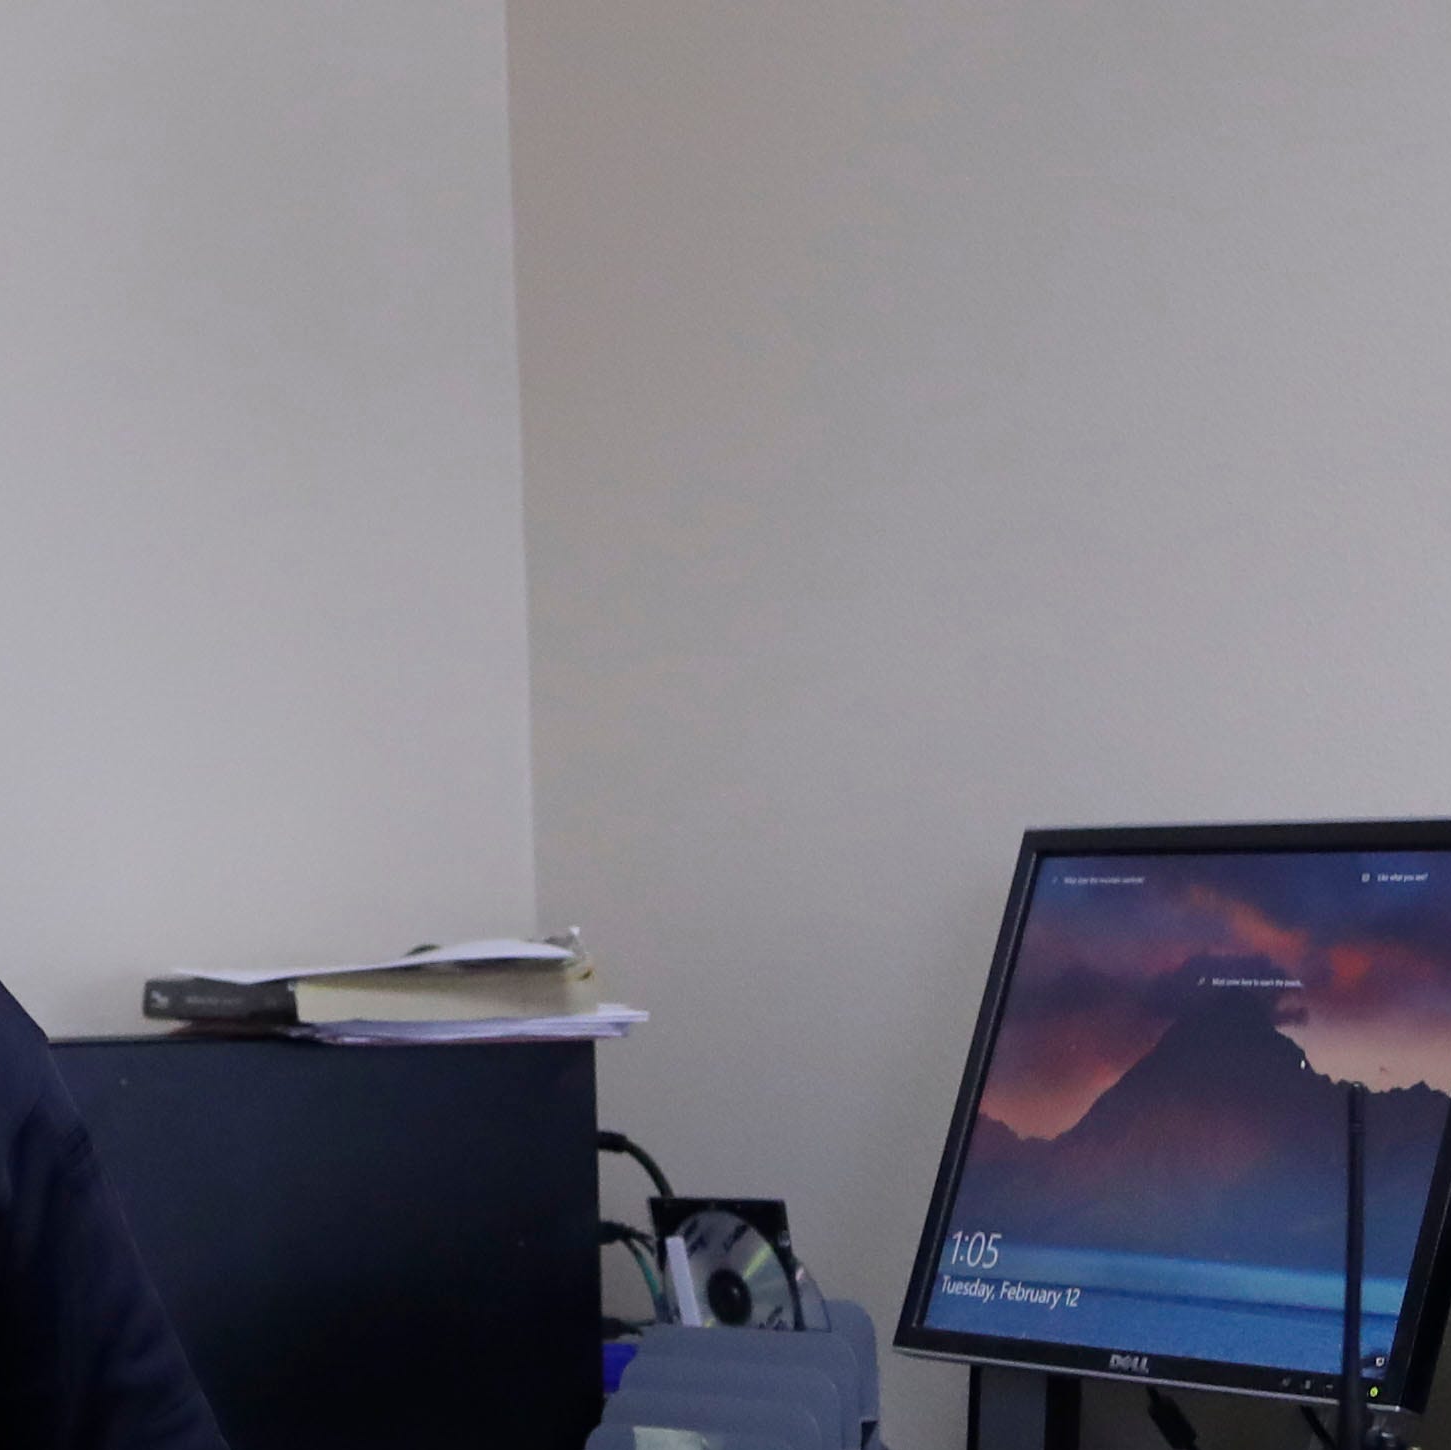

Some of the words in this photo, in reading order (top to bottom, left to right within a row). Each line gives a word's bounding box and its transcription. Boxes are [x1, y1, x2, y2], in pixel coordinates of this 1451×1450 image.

[951, 1231, 1002, 1269] 1:05
[941, 1275, 995, 1303] Tuesday,
[999, 1281, 1062, 1310] February
[1064, 1287, 1081, 1308] 12
[1109, 1354, 1150, 1374] DELL
